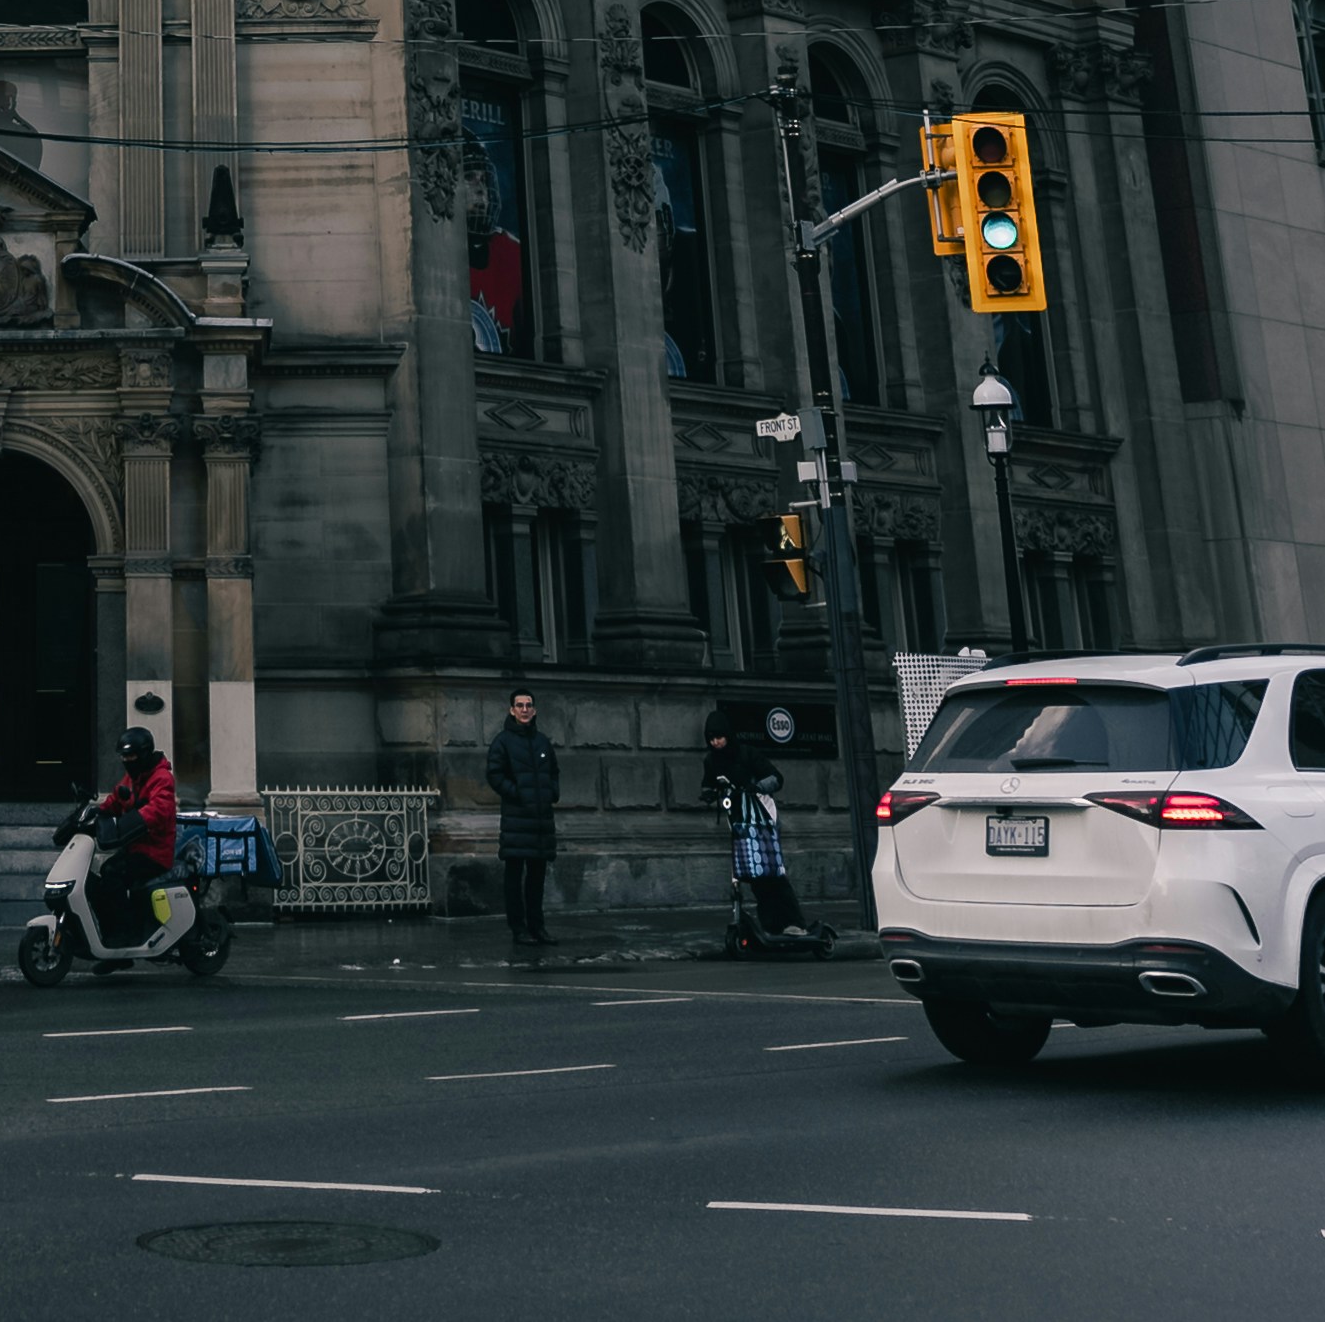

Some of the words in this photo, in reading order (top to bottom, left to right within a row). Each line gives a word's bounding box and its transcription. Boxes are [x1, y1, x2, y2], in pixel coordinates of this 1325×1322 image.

[461, 98, 506, 126] ERILL
[760, 419, 786, 434] FRONT
[772, 718, 790, 731] Esso
